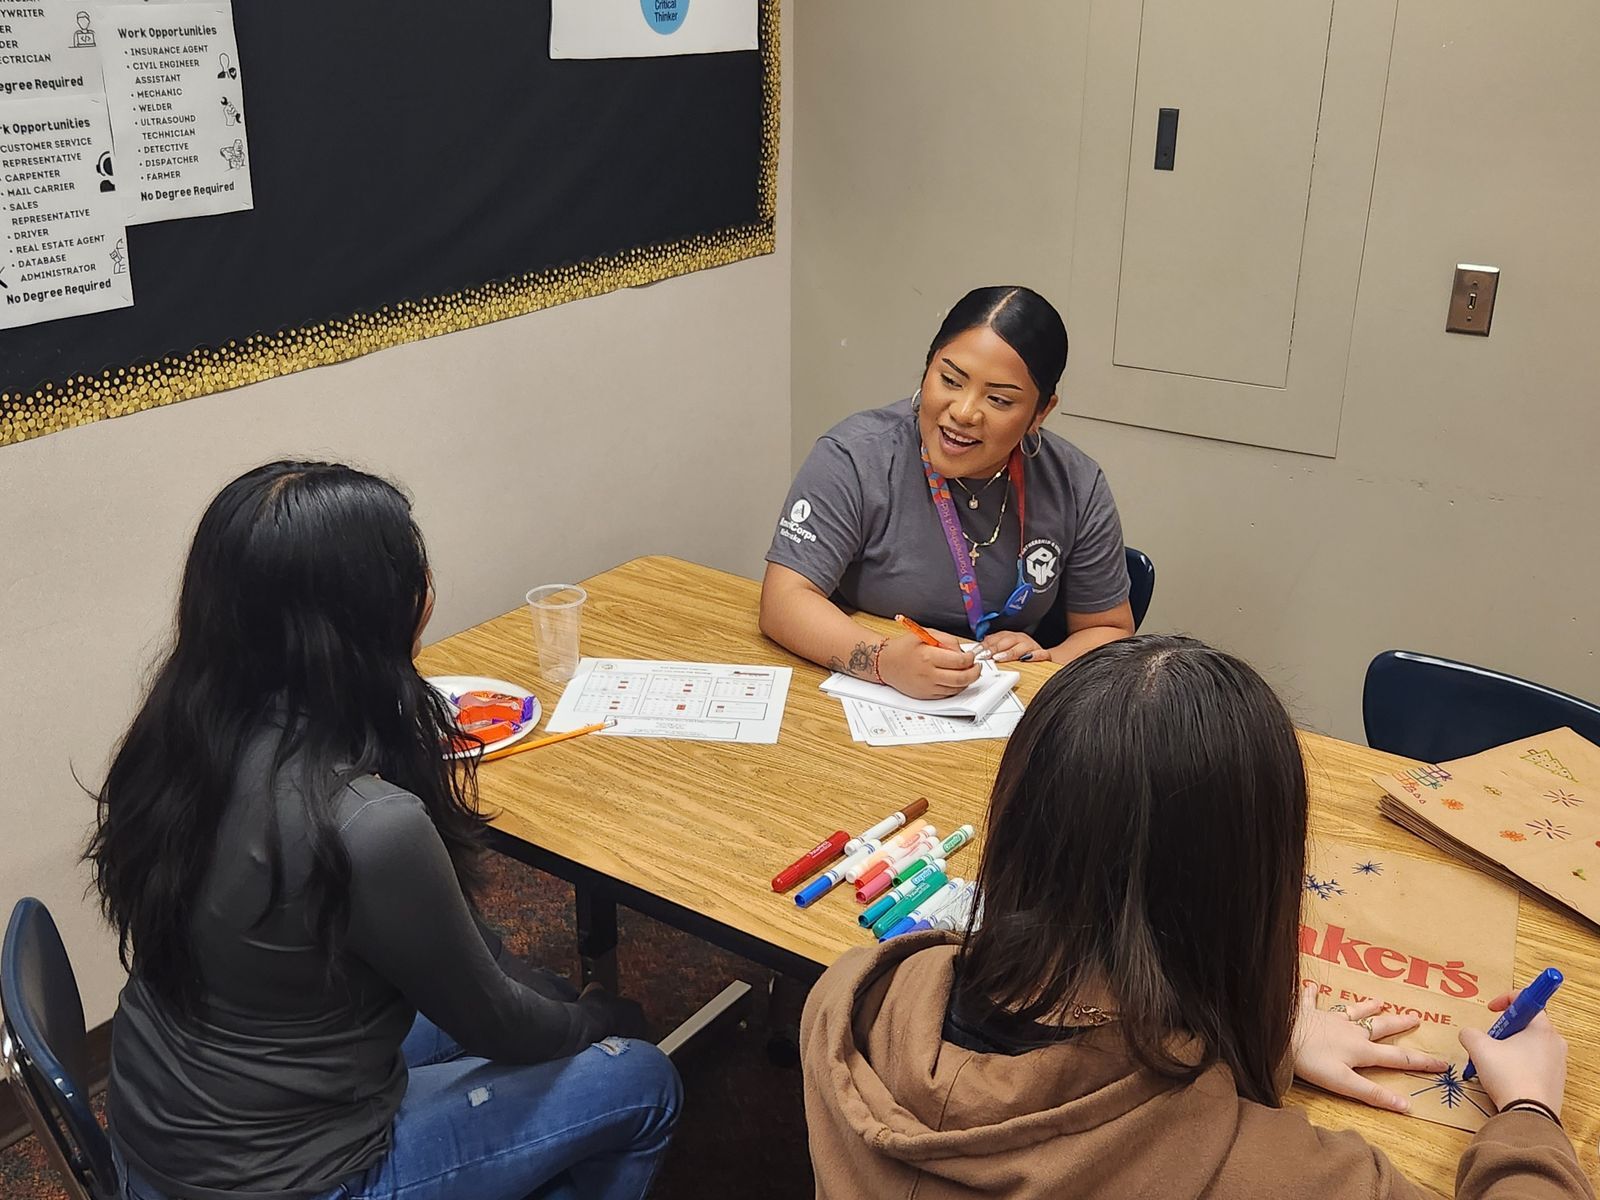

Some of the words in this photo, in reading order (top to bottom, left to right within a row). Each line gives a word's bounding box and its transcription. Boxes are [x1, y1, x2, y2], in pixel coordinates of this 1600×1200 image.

[655, 12, 678, 23] Thinker
[118, 28, 147, 39] Work
[149, 25, 217, 39] Opportunities
[131, 46, 180, 56] INSURANCE
[183, 45, 208, 53] AGENT
[133, 61, 158, 70] CIVIL
[160, 59, 200, 69] ENGINEER
[35, 76, 84, 90] Required
[135, 74, 181, 84] ASSISTANT
[137, 88, 183, 98] MECHANIC
[139, 103, 172, 112] WELDER
[12, 118, 91, 135] Opportunities
[141, 115, 196, 127] ULTRASOUND
[142, 128, 196, 140] TECHNICIAN
[0, 141, 53, 153] CUSTOMER
[54, 137, 92, 149] SERVICE
[144, 143, 189, 153] DETECTIVE
[3, 153, 82, 168] REPRESENTATIVE
[145, 155, 199, 167] DISPATCHER
[5, 169, 60, 182] CARPENTER
[147, 171, 181, 181] FARMER
[7, 187, 31, 197] MAIL
[34, 182, 75, 194] CARRIER
[141, 191, 154, 201] No
[155, 188, 191, 201] Degree
[194, 181, 235, 196] Required
[9, 201, 39, 211] SALES
[12, 209, 91, 225] REPRESENTATIVE
[14, 229, 49, 240] DRIVER
[16, 244, 39, 254] REAL
[42, 239, 75, 250] ESTATE
[77, 234, 105, 245] AGENT
[18, 254, 67, 268] DATABASE
[21, 264, 97, 282] ADMINISTRATOR
[7, 294, 21, 304] No
[23, 288, 63, 302] Degree
[65, 278, 112, 295] Required
